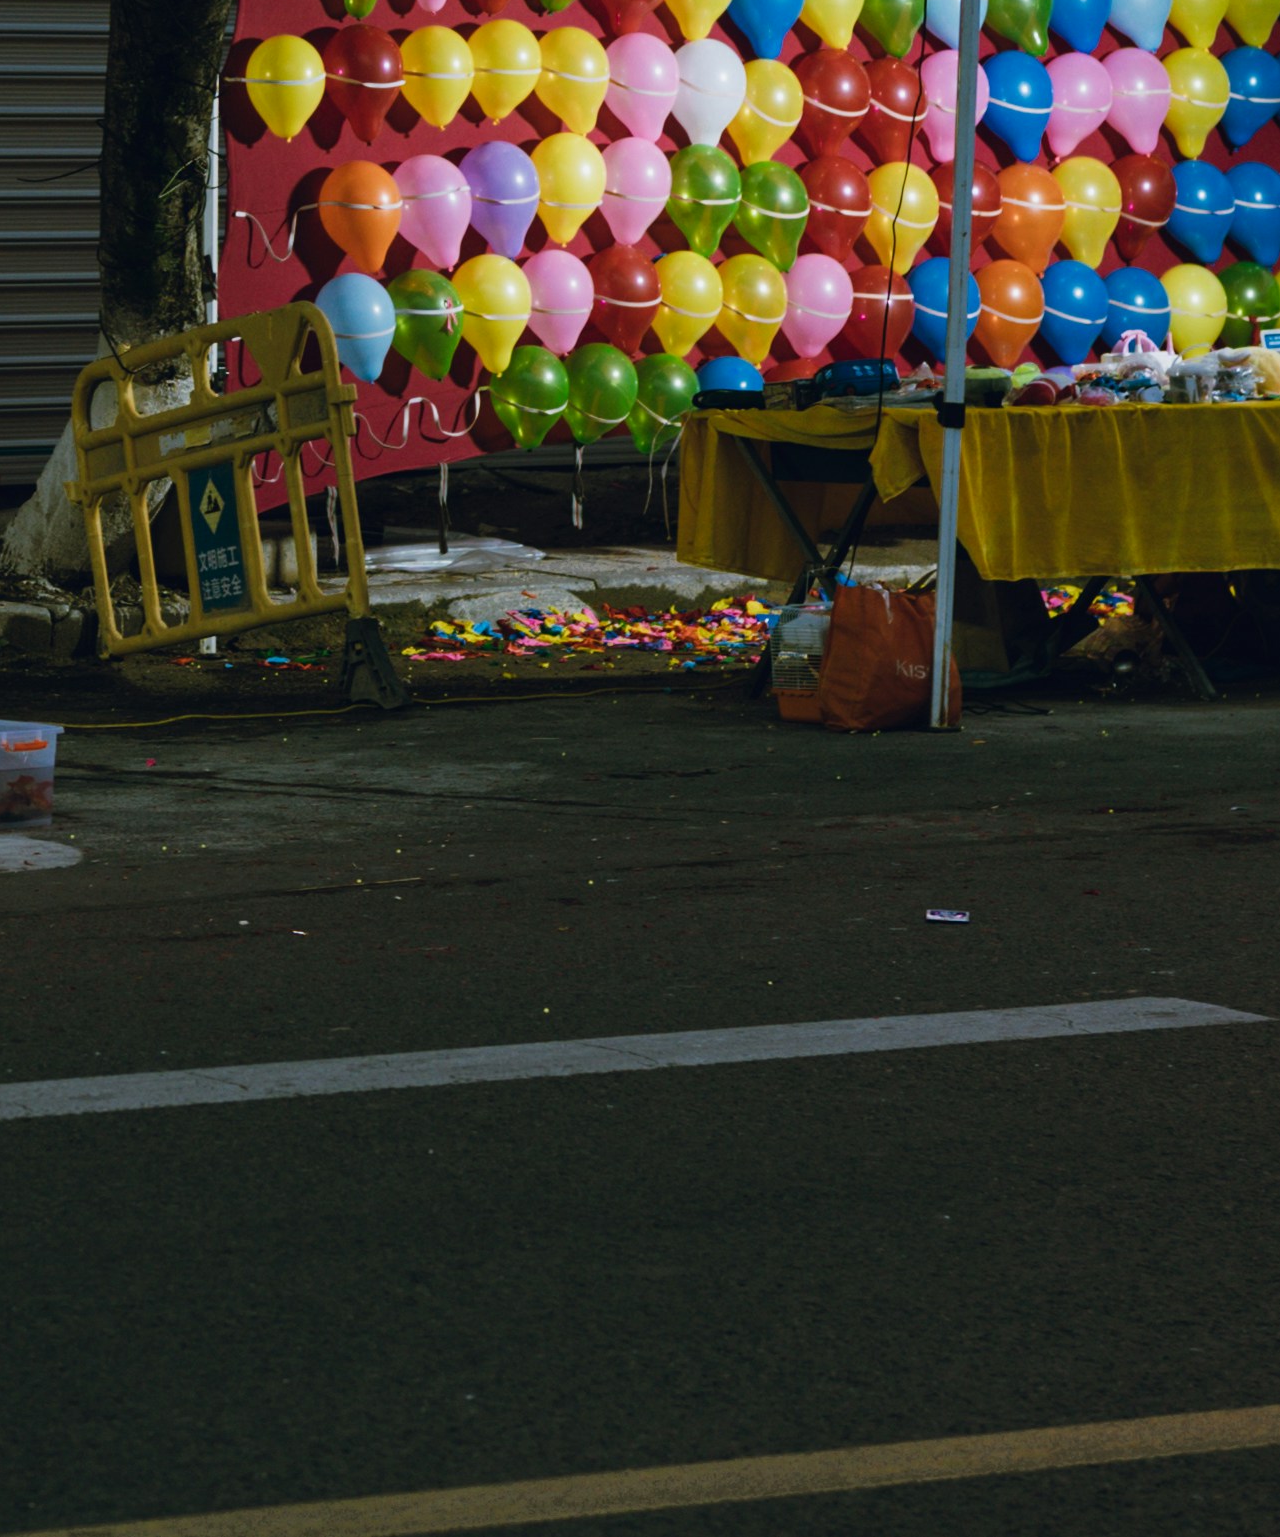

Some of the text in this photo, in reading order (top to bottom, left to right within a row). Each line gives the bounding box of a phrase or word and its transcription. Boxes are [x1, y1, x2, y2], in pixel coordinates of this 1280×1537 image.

[198, 545, 240, 573] 文明施工
[202, 573, 243, 601] 注意安全
